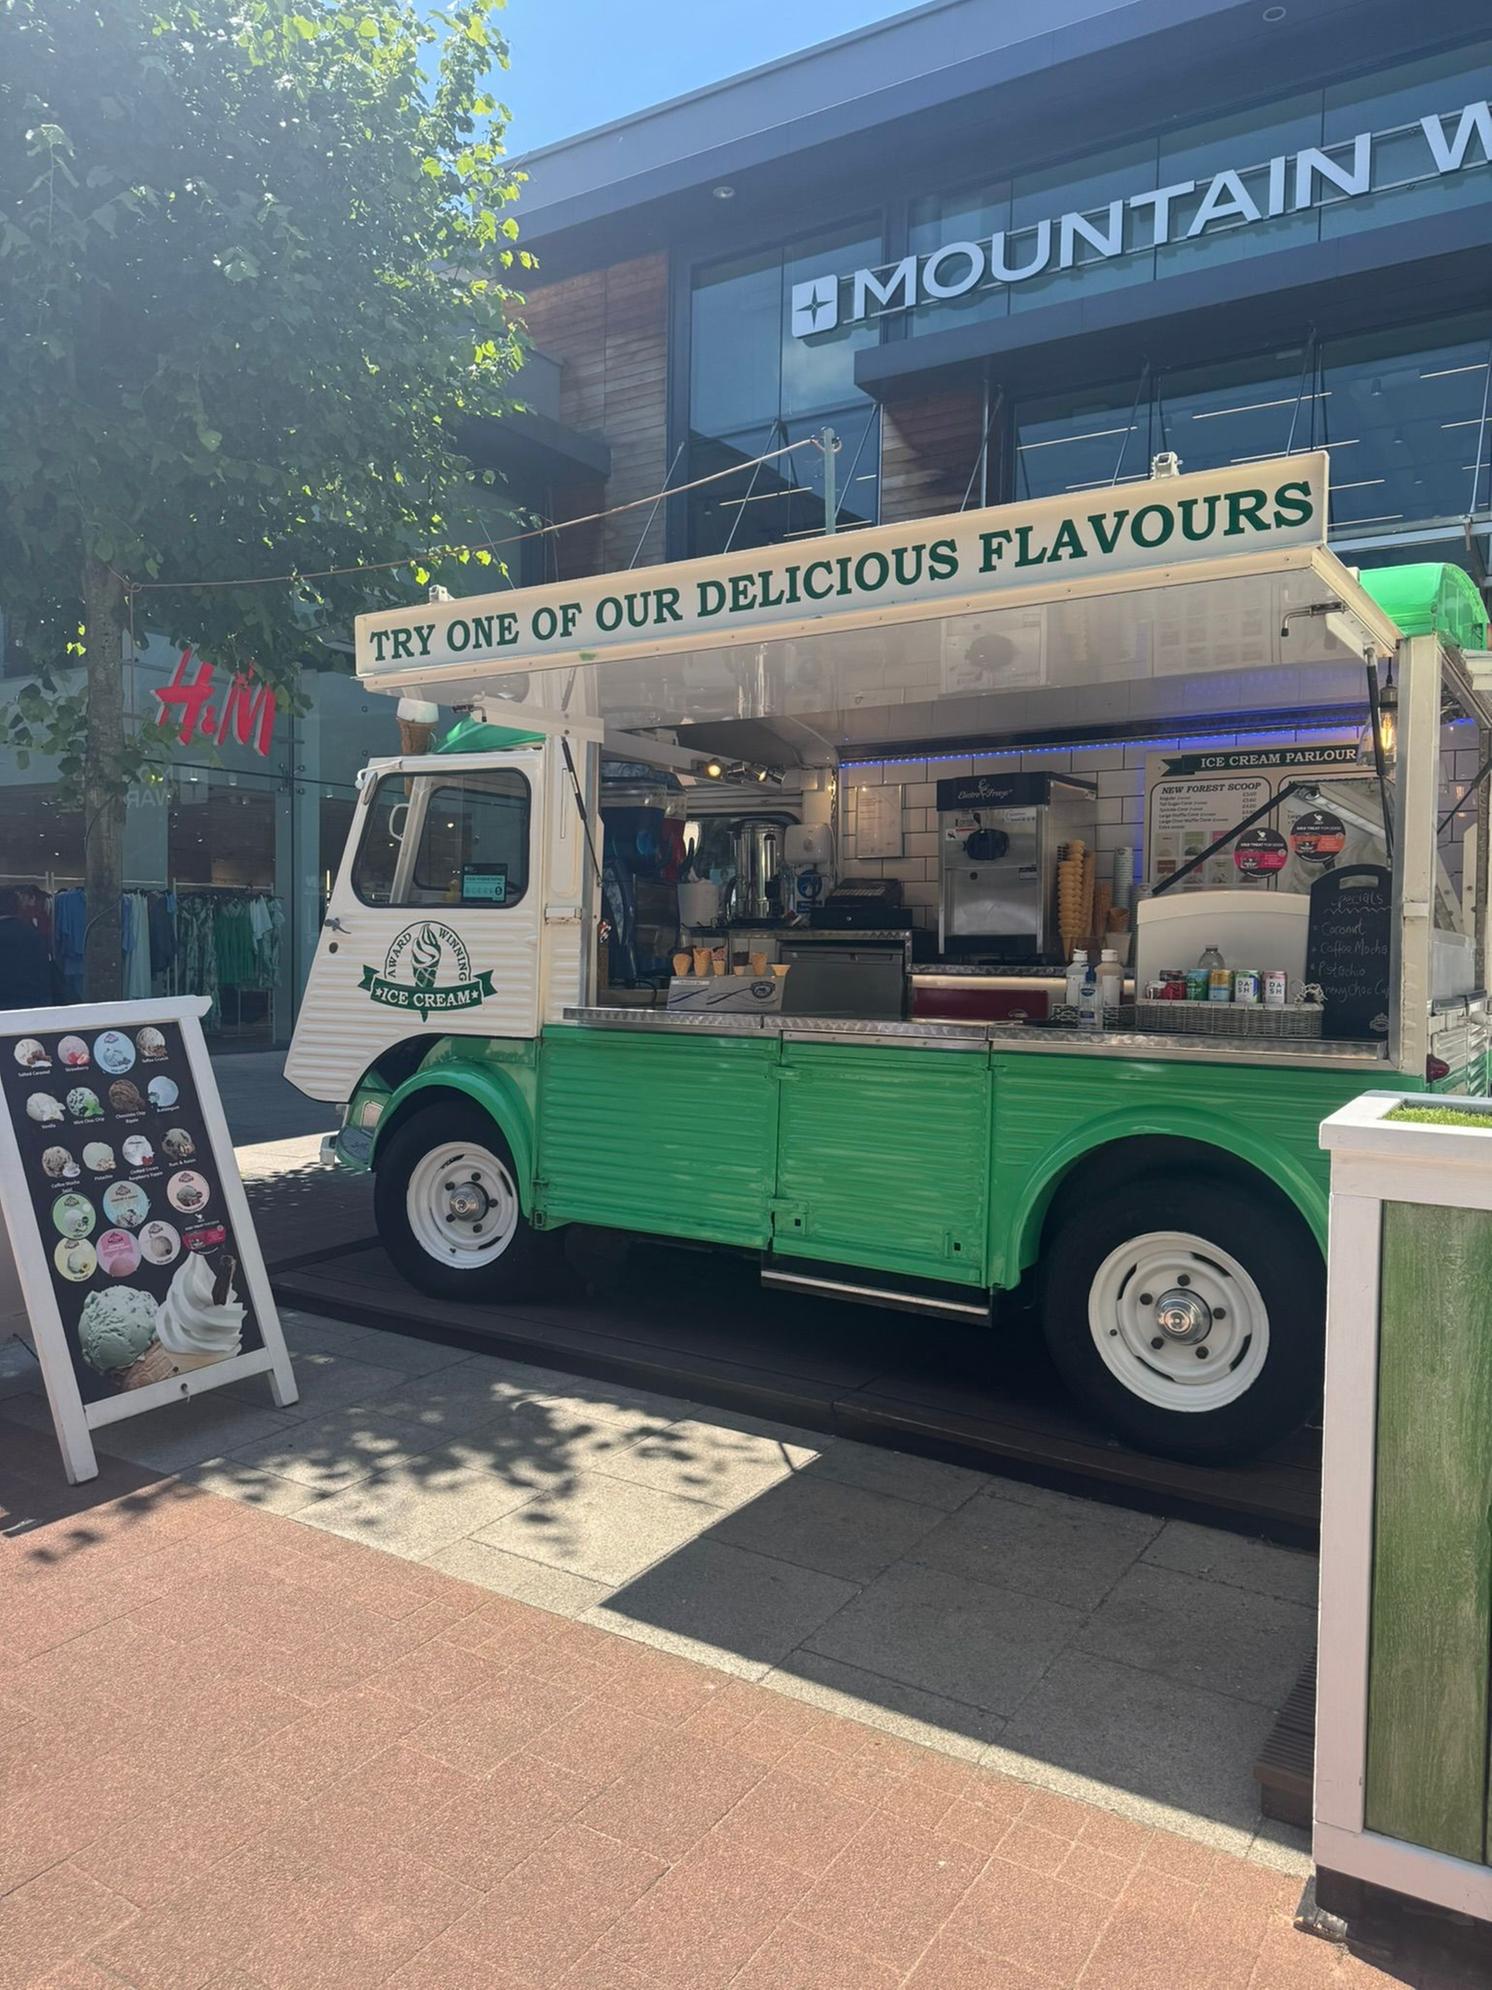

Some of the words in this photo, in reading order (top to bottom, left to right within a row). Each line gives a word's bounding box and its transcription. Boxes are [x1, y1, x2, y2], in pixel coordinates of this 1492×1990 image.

[853, 132, 1372, 320] MOUNTAIN
[370, 624, 436, 662] TRY
[447, 612, 519, 652] ONE
[531, 602, 583, 640] OF
[596, 587, 684, 631] OUR
[697, 538, 959, 618] DELICIOUS
[979, 481, 1315, 573] FLAVOURS
[151, 646, 277, 757] H&M
[1201, 757, 1225, 768] ICE
[1229, 754, 1281, 766] CREAM
[1286, 749, 1357, 763] PARLOUR
[1161, 786, 1184, 794] NEW
[1186, 784, 1226, 793] FOREST
[1227, 782, 1261, 791] SCOOP
[387, 932, 412, 978] AWARD
[438, 927, 468, 982] WINNING
[381, 988, 408, 1005] ICE
[412, 990, 471, 1007] CREAM
